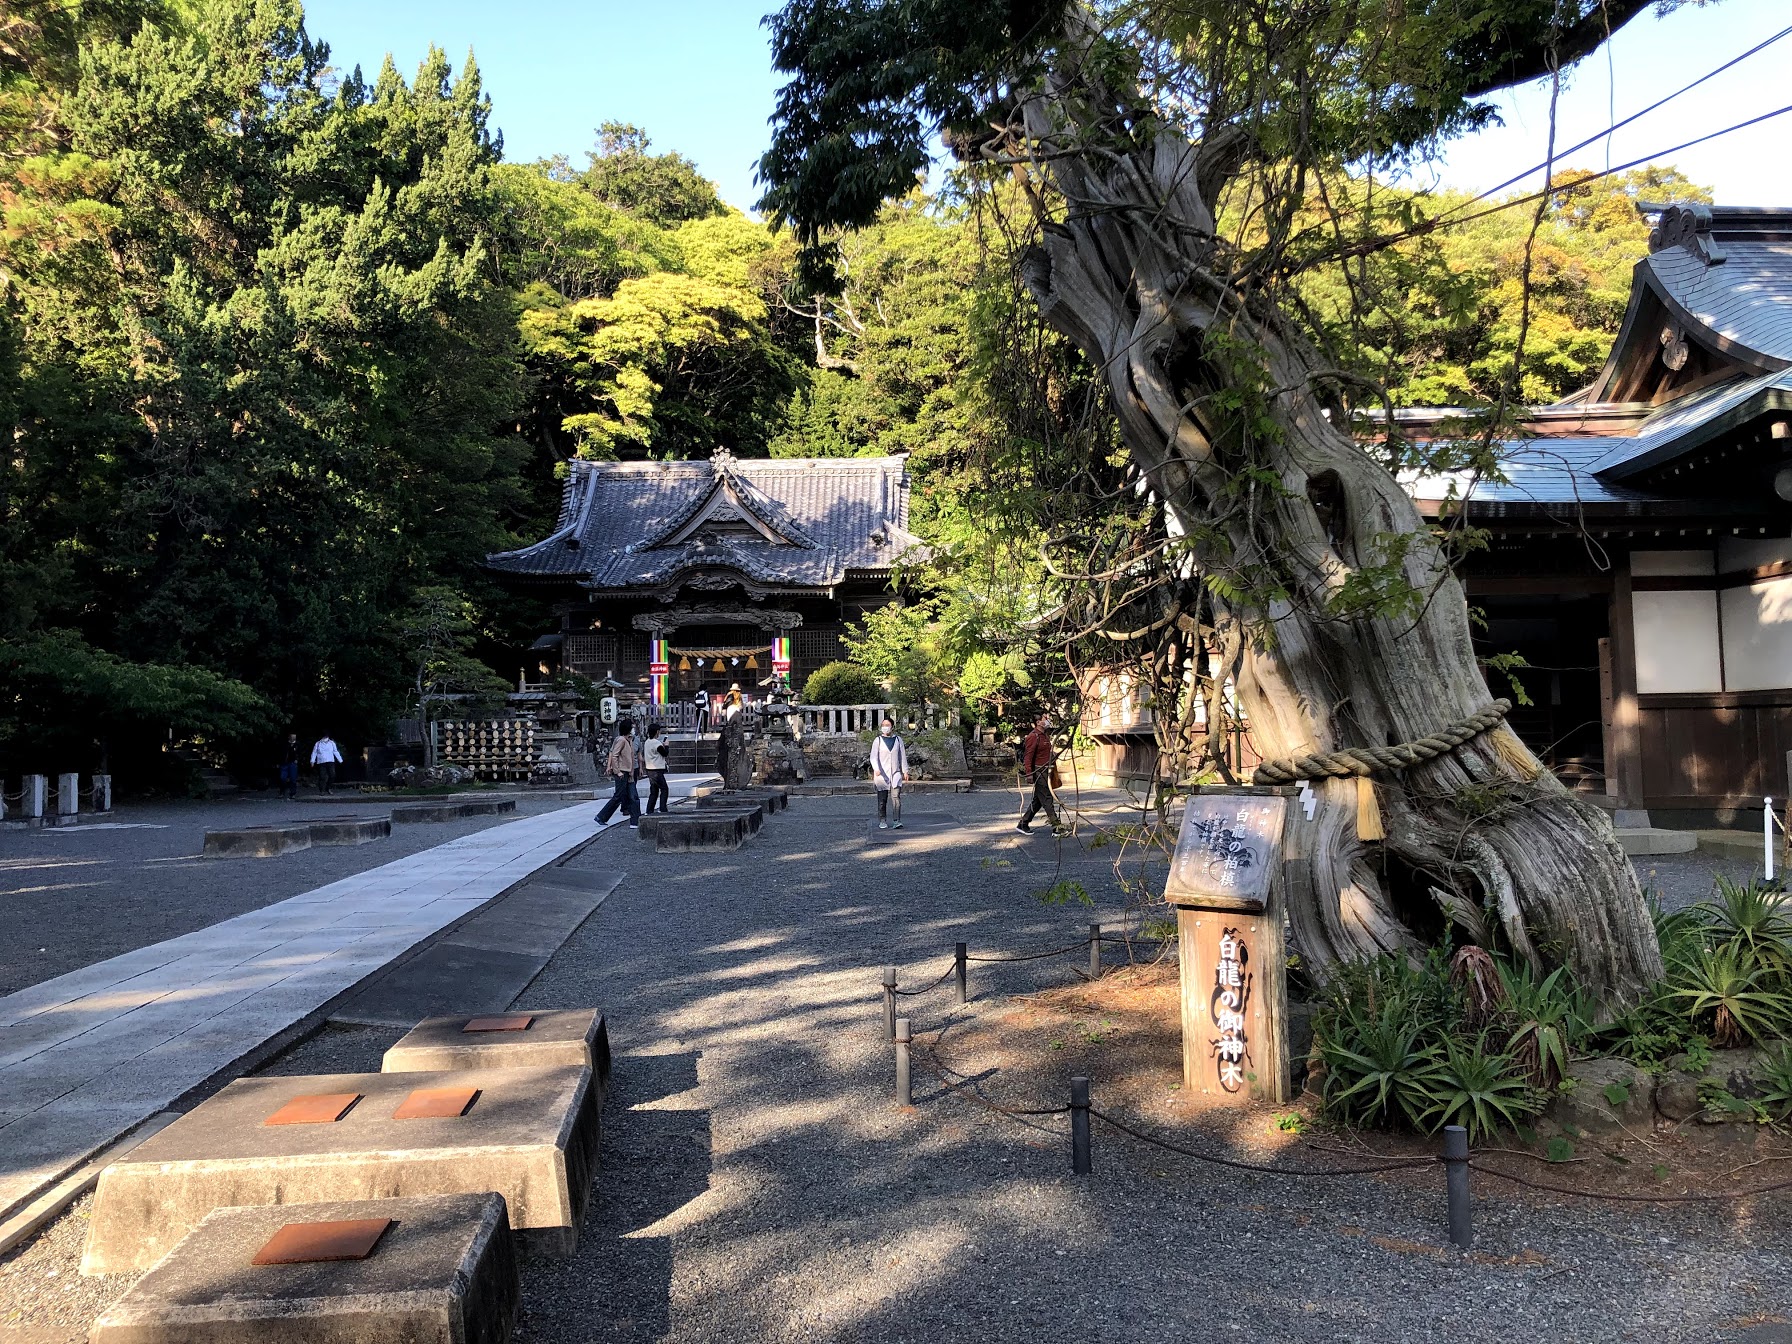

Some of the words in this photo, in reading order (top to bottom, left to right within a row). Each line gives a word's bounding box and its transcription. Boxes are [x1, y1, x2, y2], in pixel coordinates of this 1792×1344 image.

[1216, 934, 1244, 1087] 白龍の御神木
